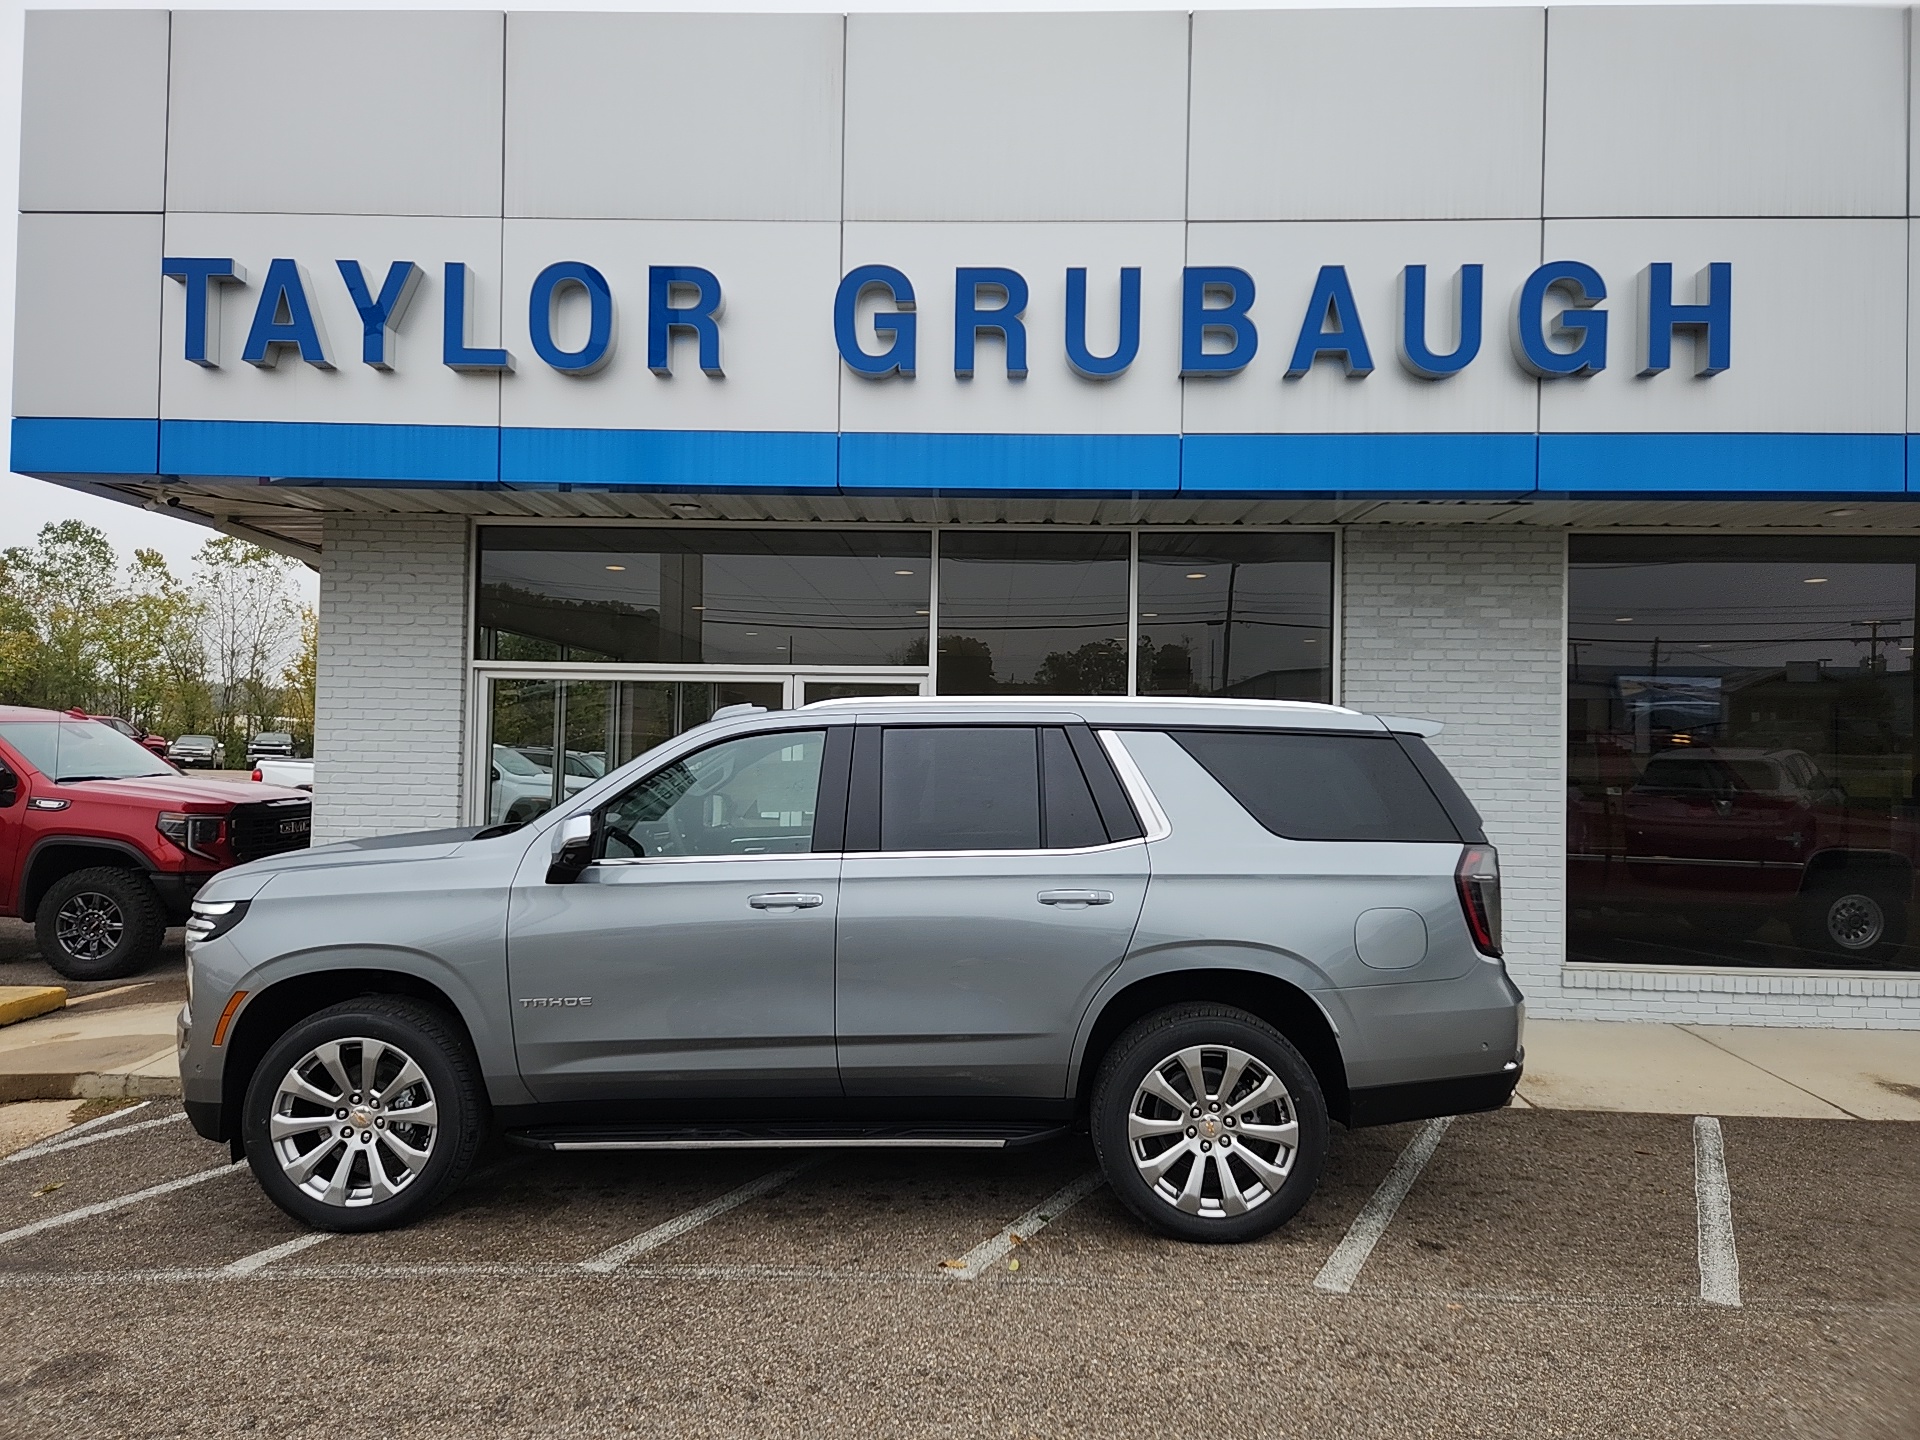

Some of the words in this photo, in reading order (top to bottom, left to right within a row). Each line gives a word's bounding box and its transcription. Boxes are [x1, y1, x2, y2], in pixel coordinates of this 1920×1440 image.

[162, 257, 726, 377] TAYLOR
[833, 260, 1732, 380] GRUBAUGH
[280, 820, 309, 833] GMC
[518, 996, 593, 1008] TAHOE
